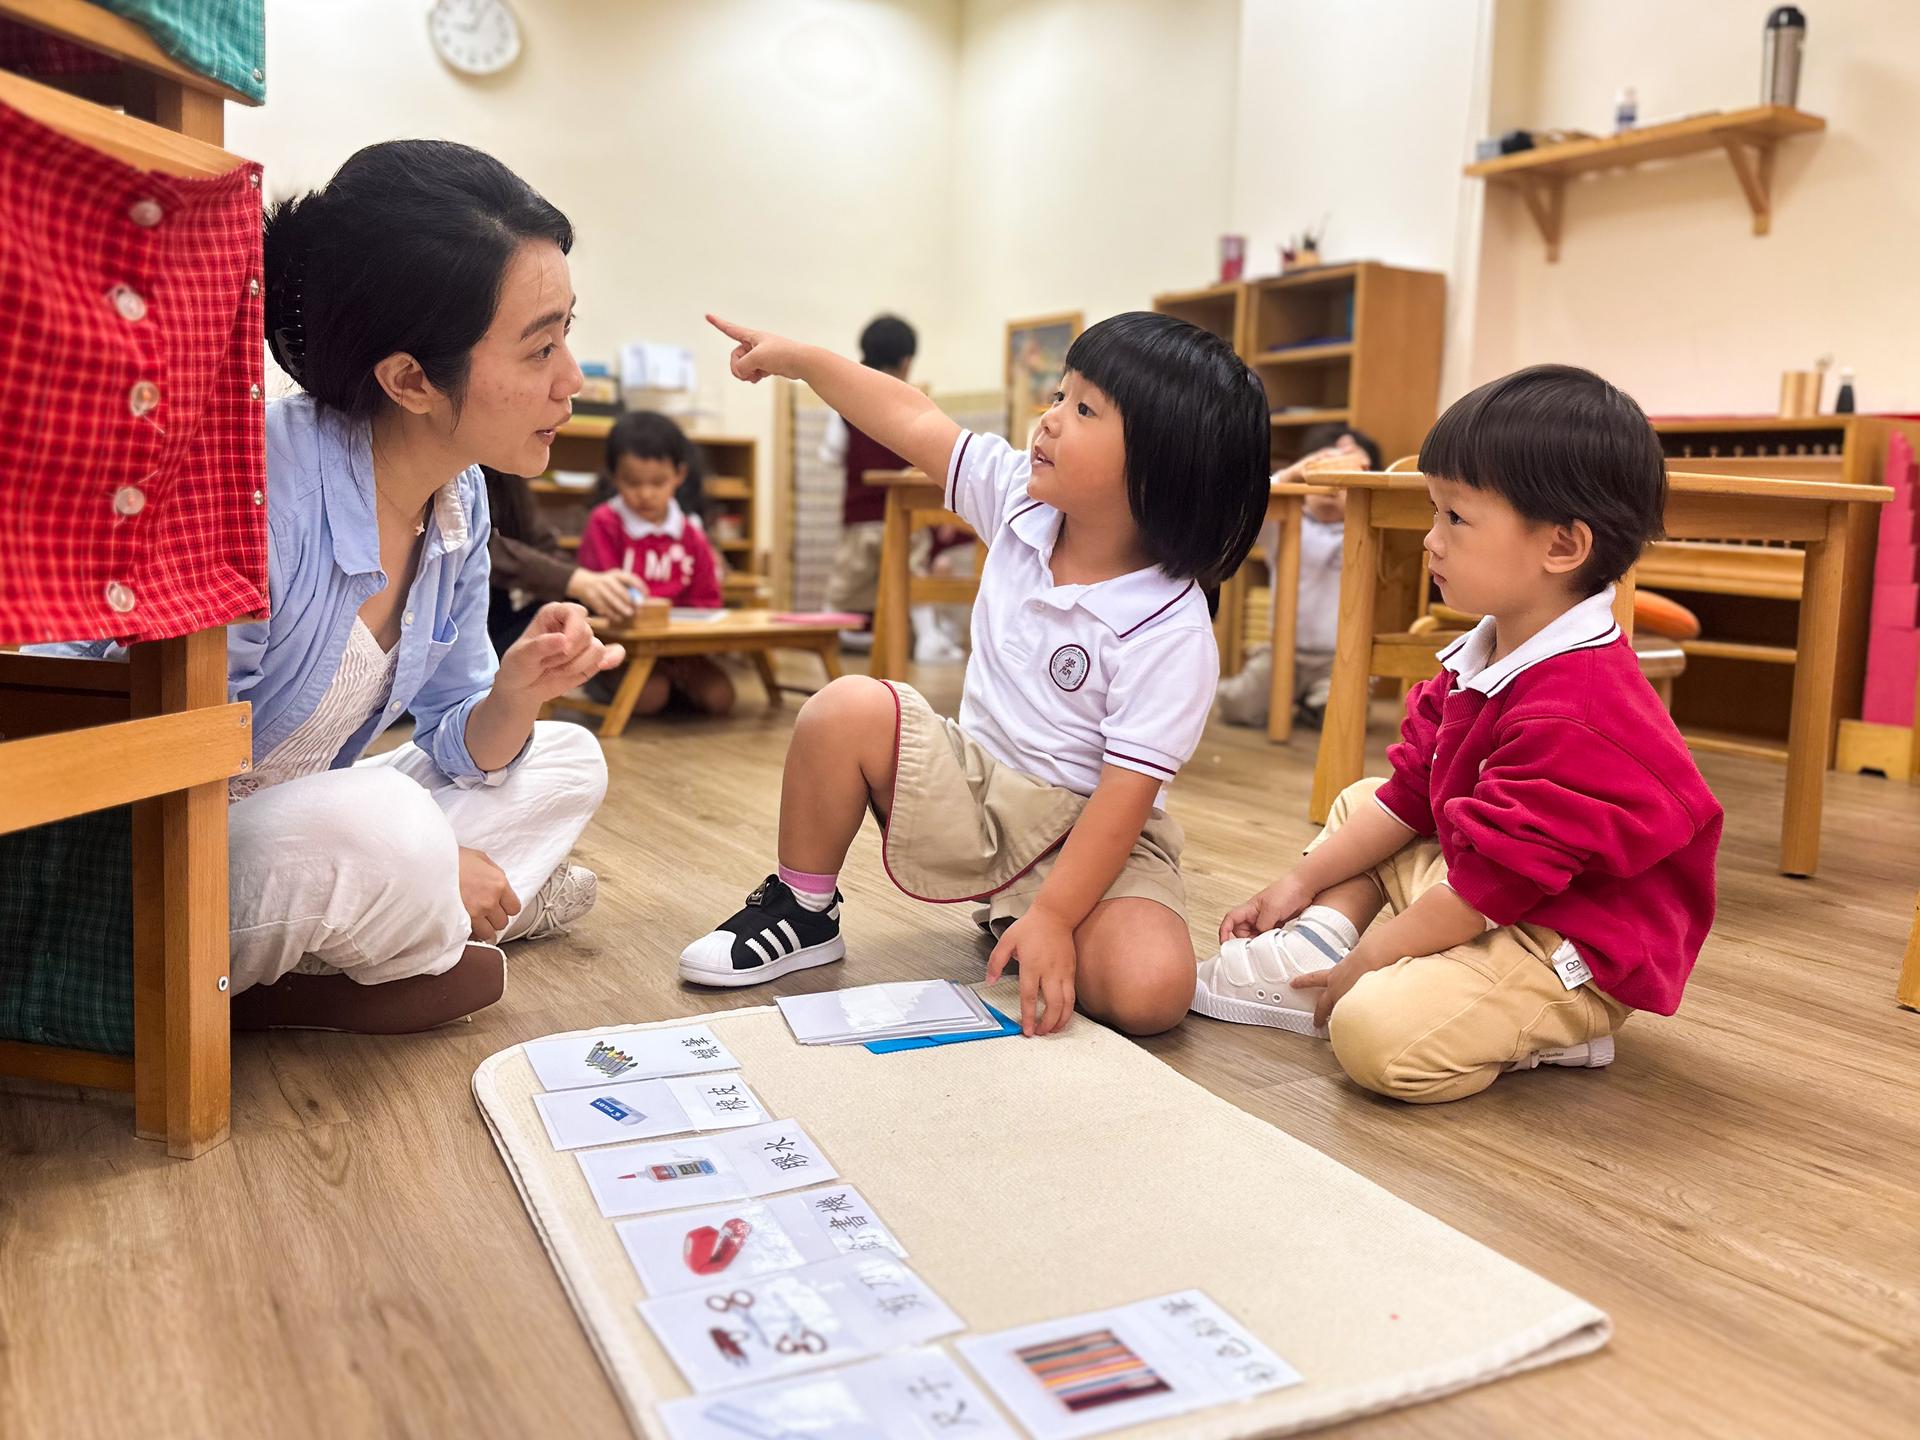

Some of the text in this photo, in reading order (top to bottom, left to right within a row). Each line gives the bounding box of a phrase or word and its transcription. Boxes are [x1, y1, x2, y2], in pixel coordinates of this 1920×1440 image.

[596, 1101, 614, 1113] PILOT
[707, 1084, 749, 1111] 橡皮
[764, 1136, 809, 1171] 膠水
